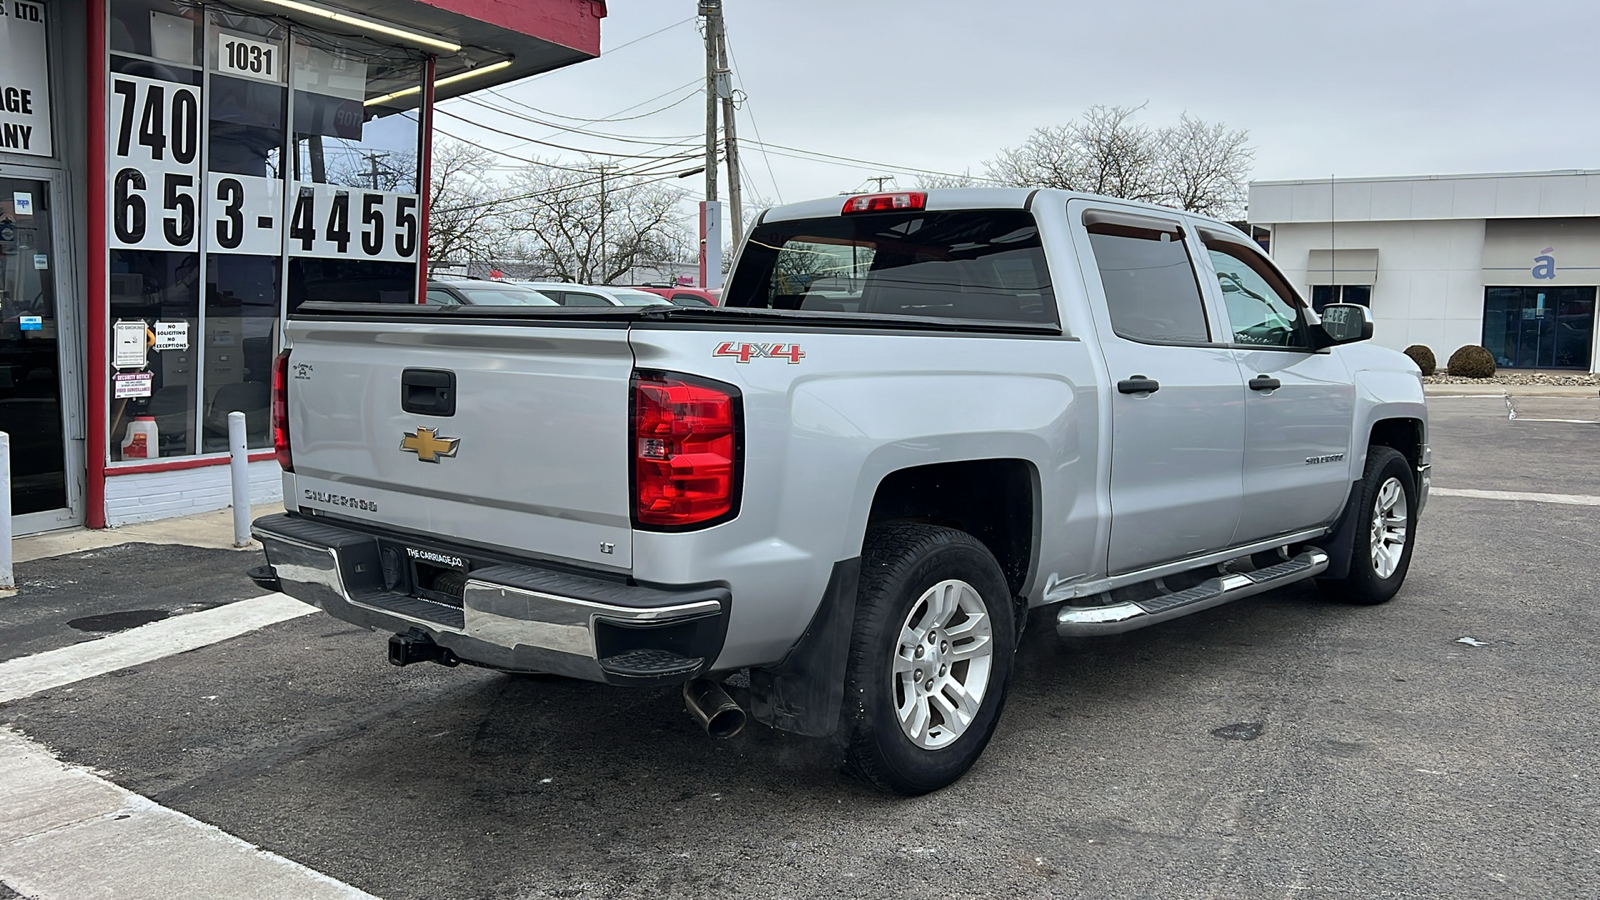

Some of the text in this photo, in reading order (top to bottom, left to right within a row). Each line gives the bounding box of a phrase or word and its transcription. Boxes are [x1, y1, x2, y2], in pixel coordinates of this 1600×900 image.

[14, 1, 43, 23] LTD.
[226, 41, 272, 75] 1031
[115, 79, 197, 164] 740
[0, 122, 32, 150] NY
[304, 489, 378, 512] SILVERADO
